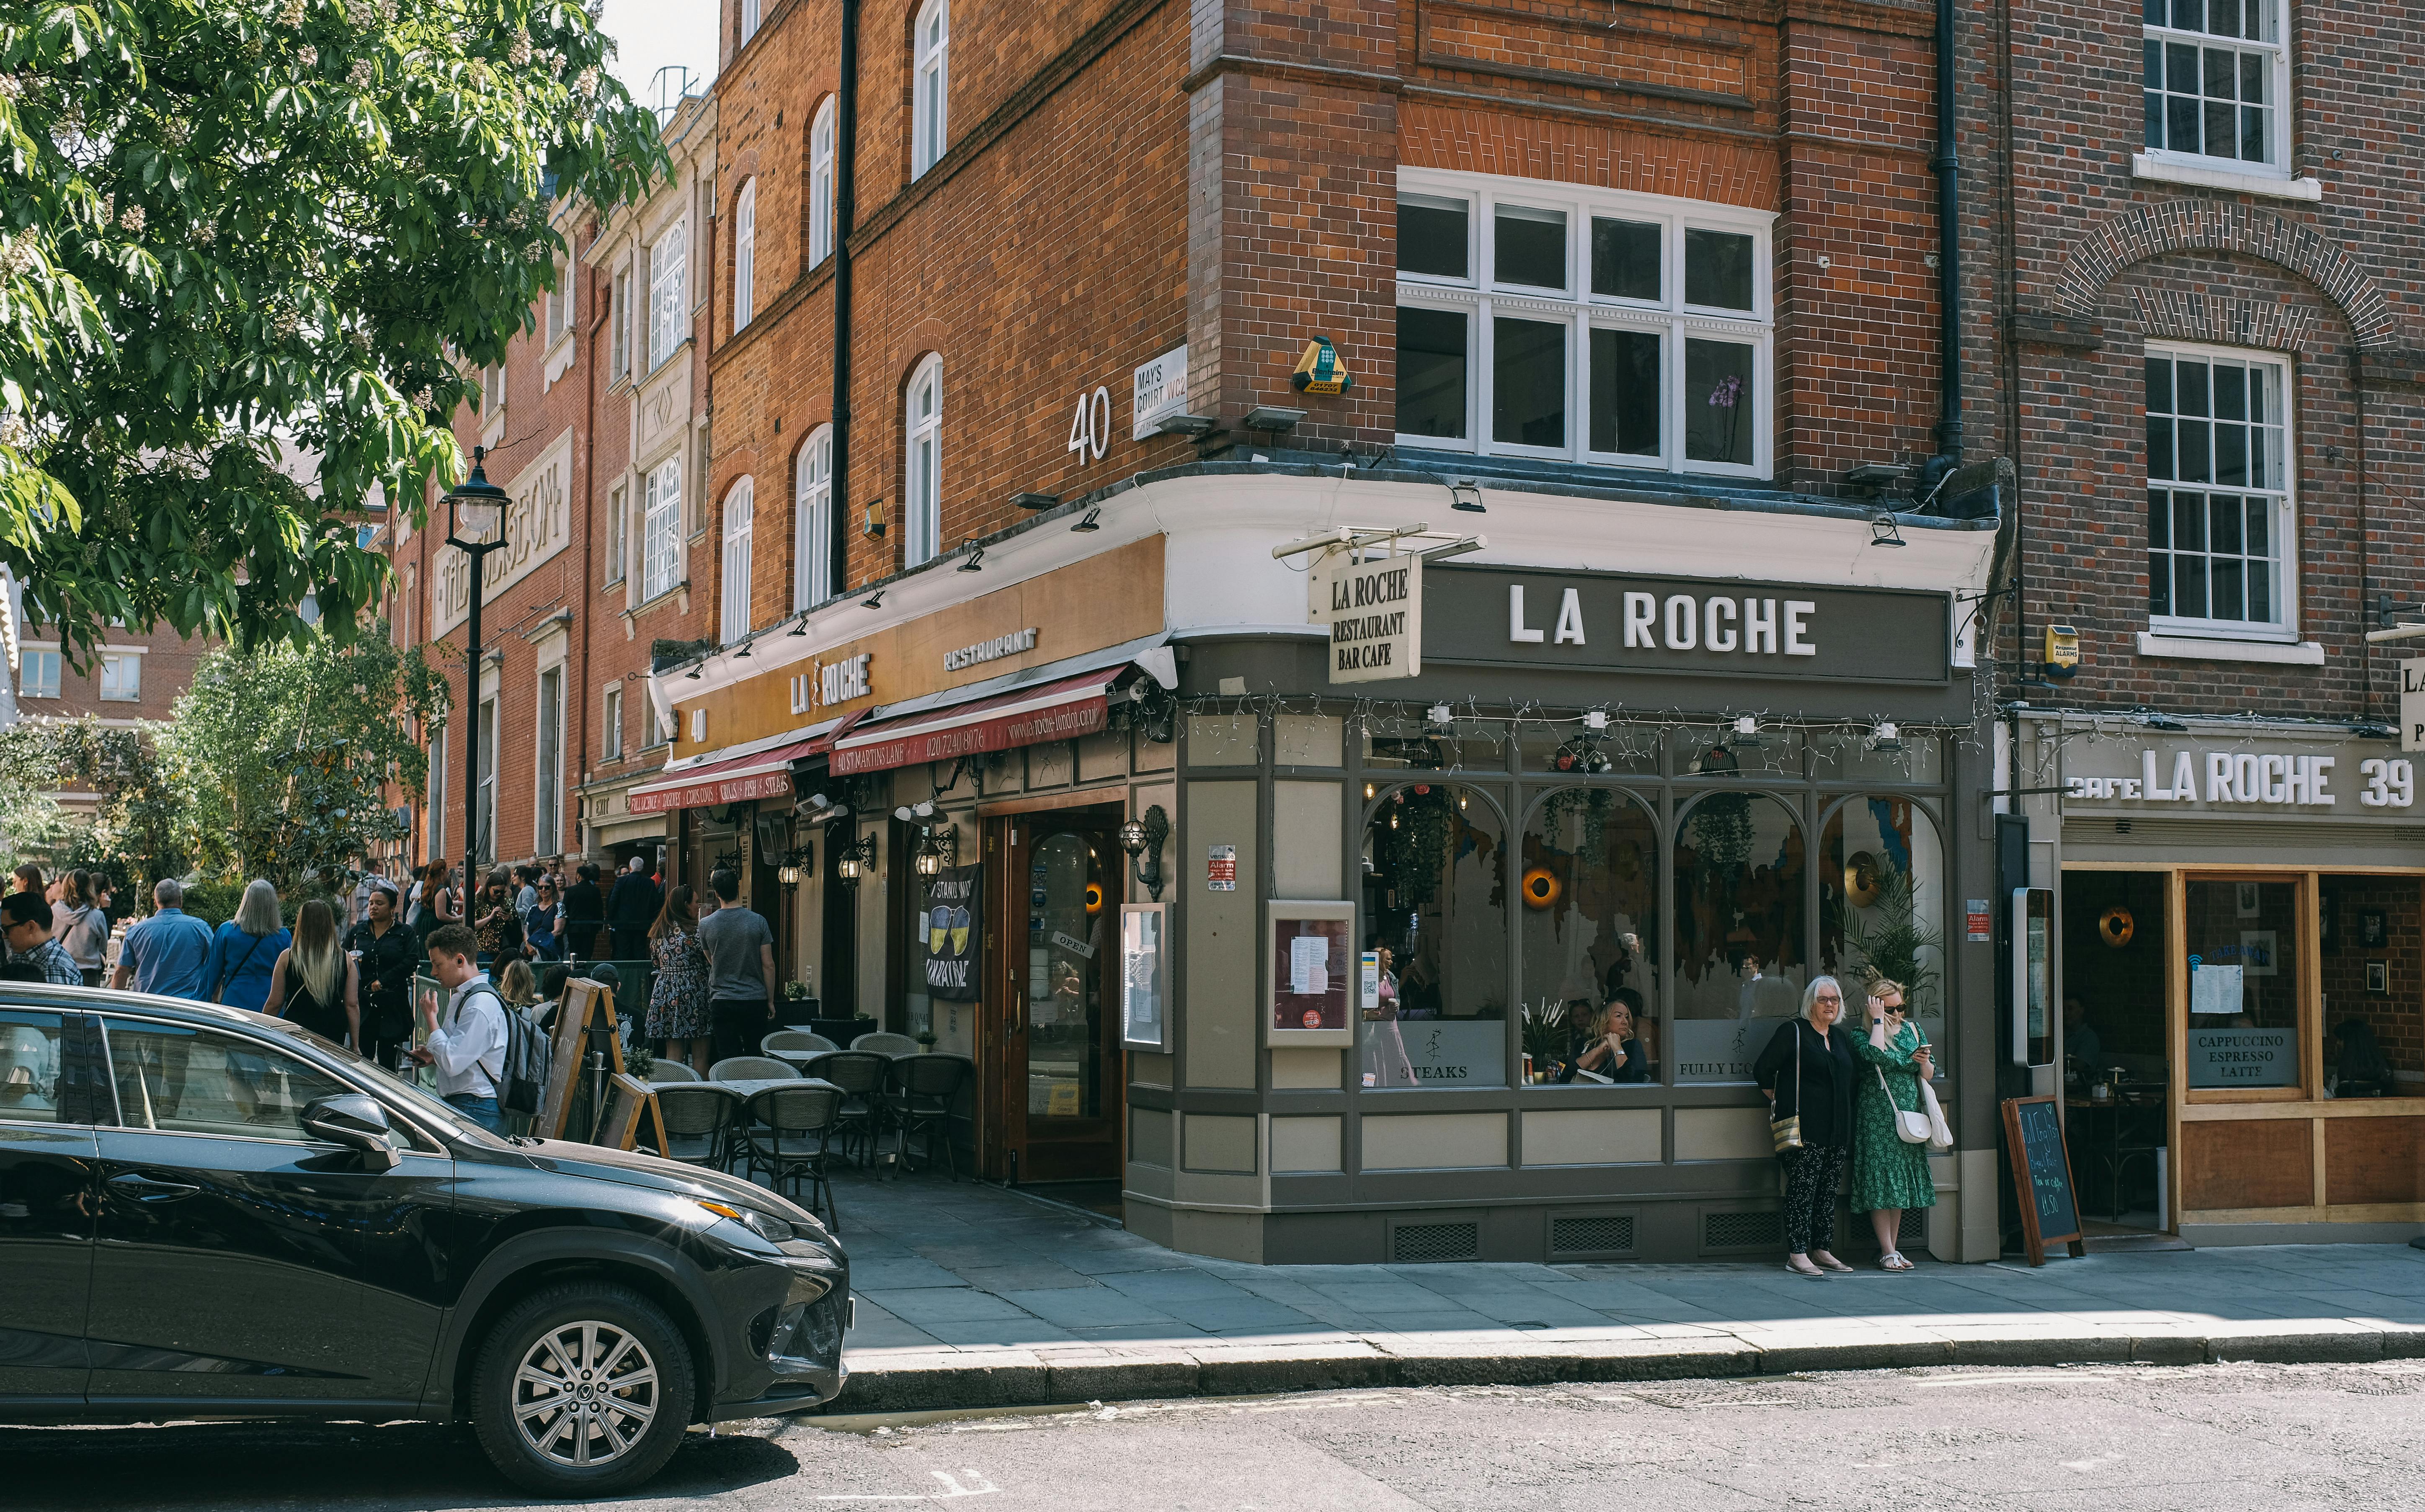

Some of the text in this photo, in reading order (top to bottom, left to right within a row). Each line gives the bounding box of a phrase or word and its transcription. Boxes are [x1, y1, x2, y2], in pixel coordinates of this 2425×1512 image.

[1138, 364, 1162, 391] MAY'S
[1312, 368, 1344, 376] Blenheim
[1138, 376, 1185, 413] COURT WC2
[1068, 386, 1110, 466] 40
[1146, 421, 1151, 430] OF
[1331, 568, 1407, 611] LA ROCHE
[1333, 611, 1405, 643] RESTAURANT
[1510, 585, 1816, 656] LA ROCHE
[944, 627, 1037, 672] RESTAURANT
[1338, 643, 1391, 670] BAR CAFE
[791, 652, 871, 715] LA ROCHE
[691, 708, 707, 743] 40
[838, 754, 845, 772] 40
[846, 752, 855, 769] ST
[855, 747, 885, 769] MARTINS
[886, 742, 904, 764] LANE
[926, 737, 941, 757] 020
[942, 732, 962, 754] 7240
[963, 727, 984, 750] 8076
[631, 797, 641, 812] FULL
[744, 779, 757, 798] FISH
[766, 774, 788, 794] STEAKS
[2064, 750, 2414, 809] CAFE LA ROCHE 39
[596, 797, 609, 817] EXIT
[937, 881, 957, 899] STAND
[958, 879, 973, 899] WIT
[1060, 936, 1086, 953] OPEN
[2210, 945, 2236, 961] TAKE
[926, 958, 969, 987] UKRAINE
[2199, 1035, 2283, 1047] CAPPUCCINO
[1680, 1063, 1725, 1075] FULLY
[2209, 1051, 2273, 1062] ESPRESSO
[1401, 1066, 1467, 1079] STEAKS
[2221, 1066, 2262, 1077] LATTE
[2034, 1175, 2043, 1186] Tea
